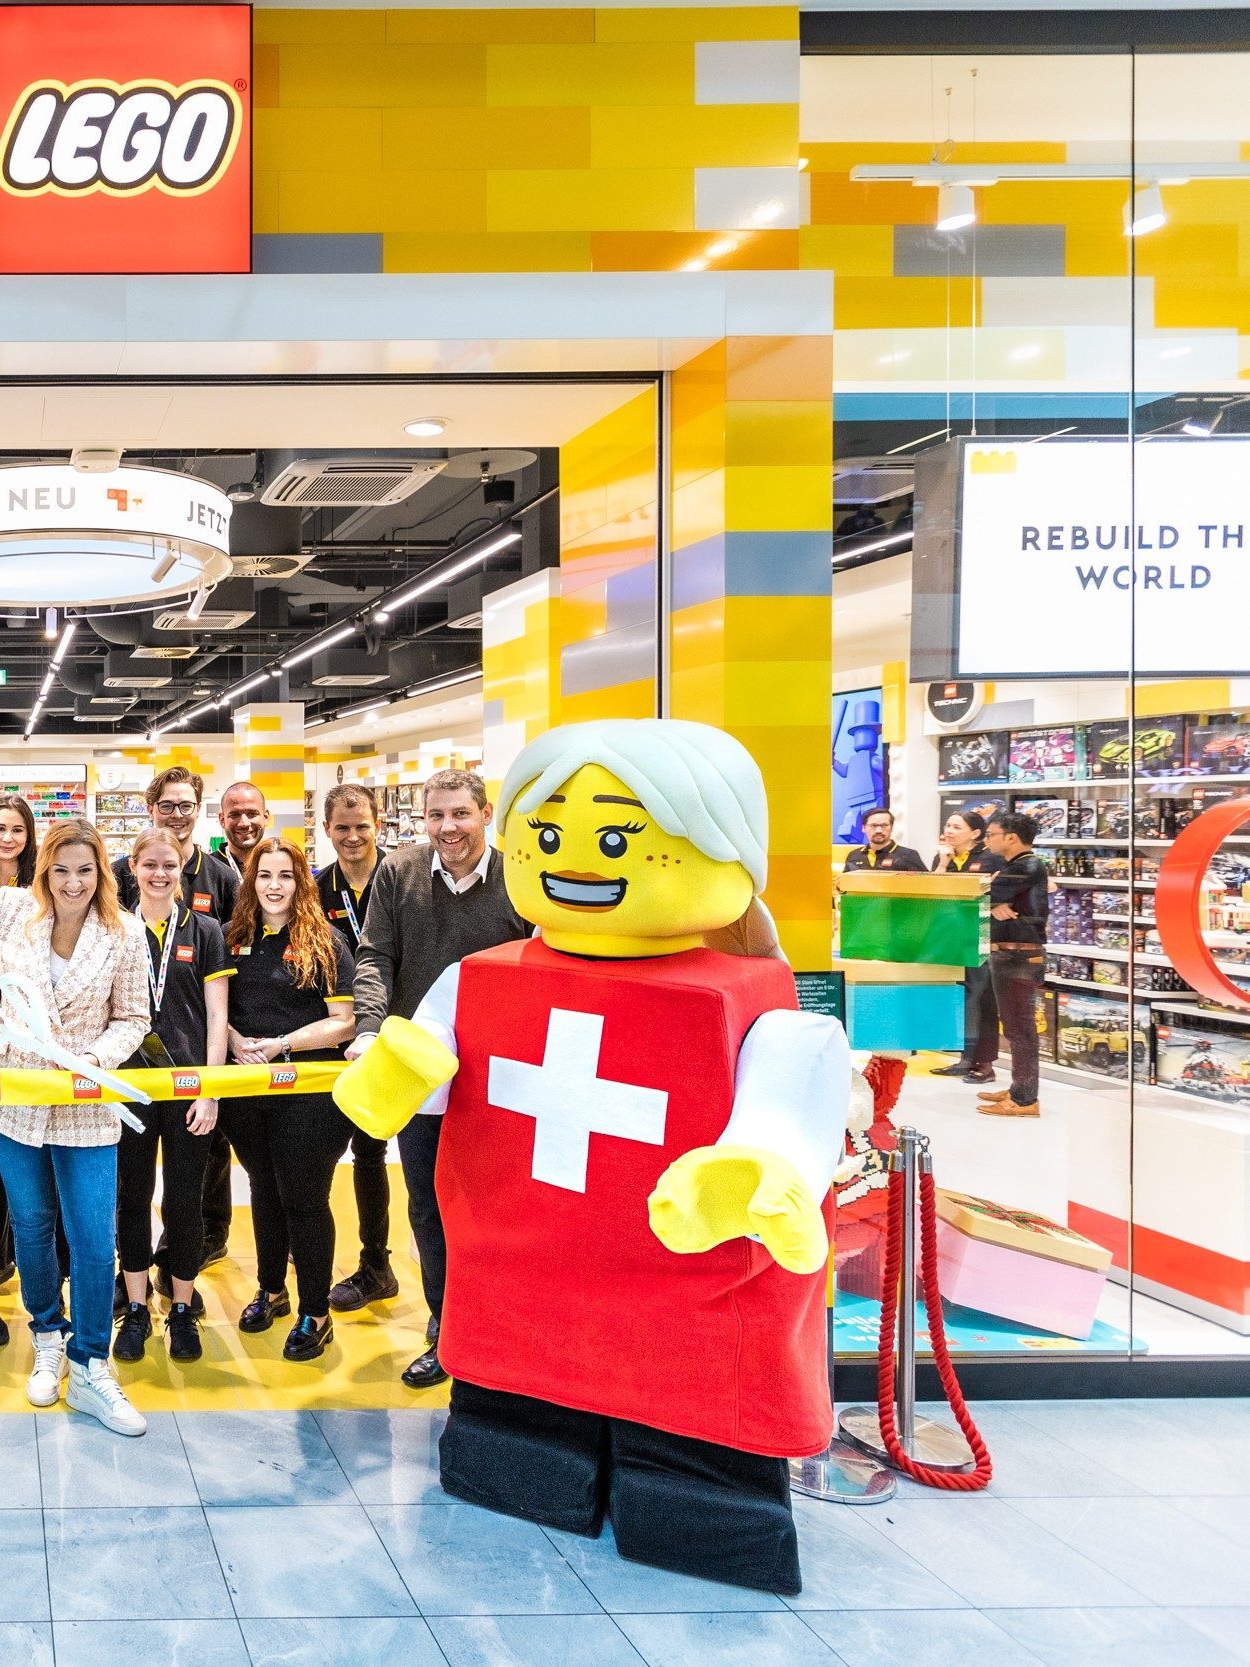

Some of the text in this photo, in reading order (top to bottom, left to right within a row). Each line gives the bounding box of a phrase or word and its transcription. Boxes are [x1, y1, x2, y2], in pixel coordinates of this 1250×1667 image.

[8, 487, 76, 511] NEU
[1021, 524, 1244, 551] REBUILD TH
[1075, 565, 1211, 591] WORLD
[175, 1075, 199, 1089] LEGO
[273, 1072, 297, 1084] LEGO
